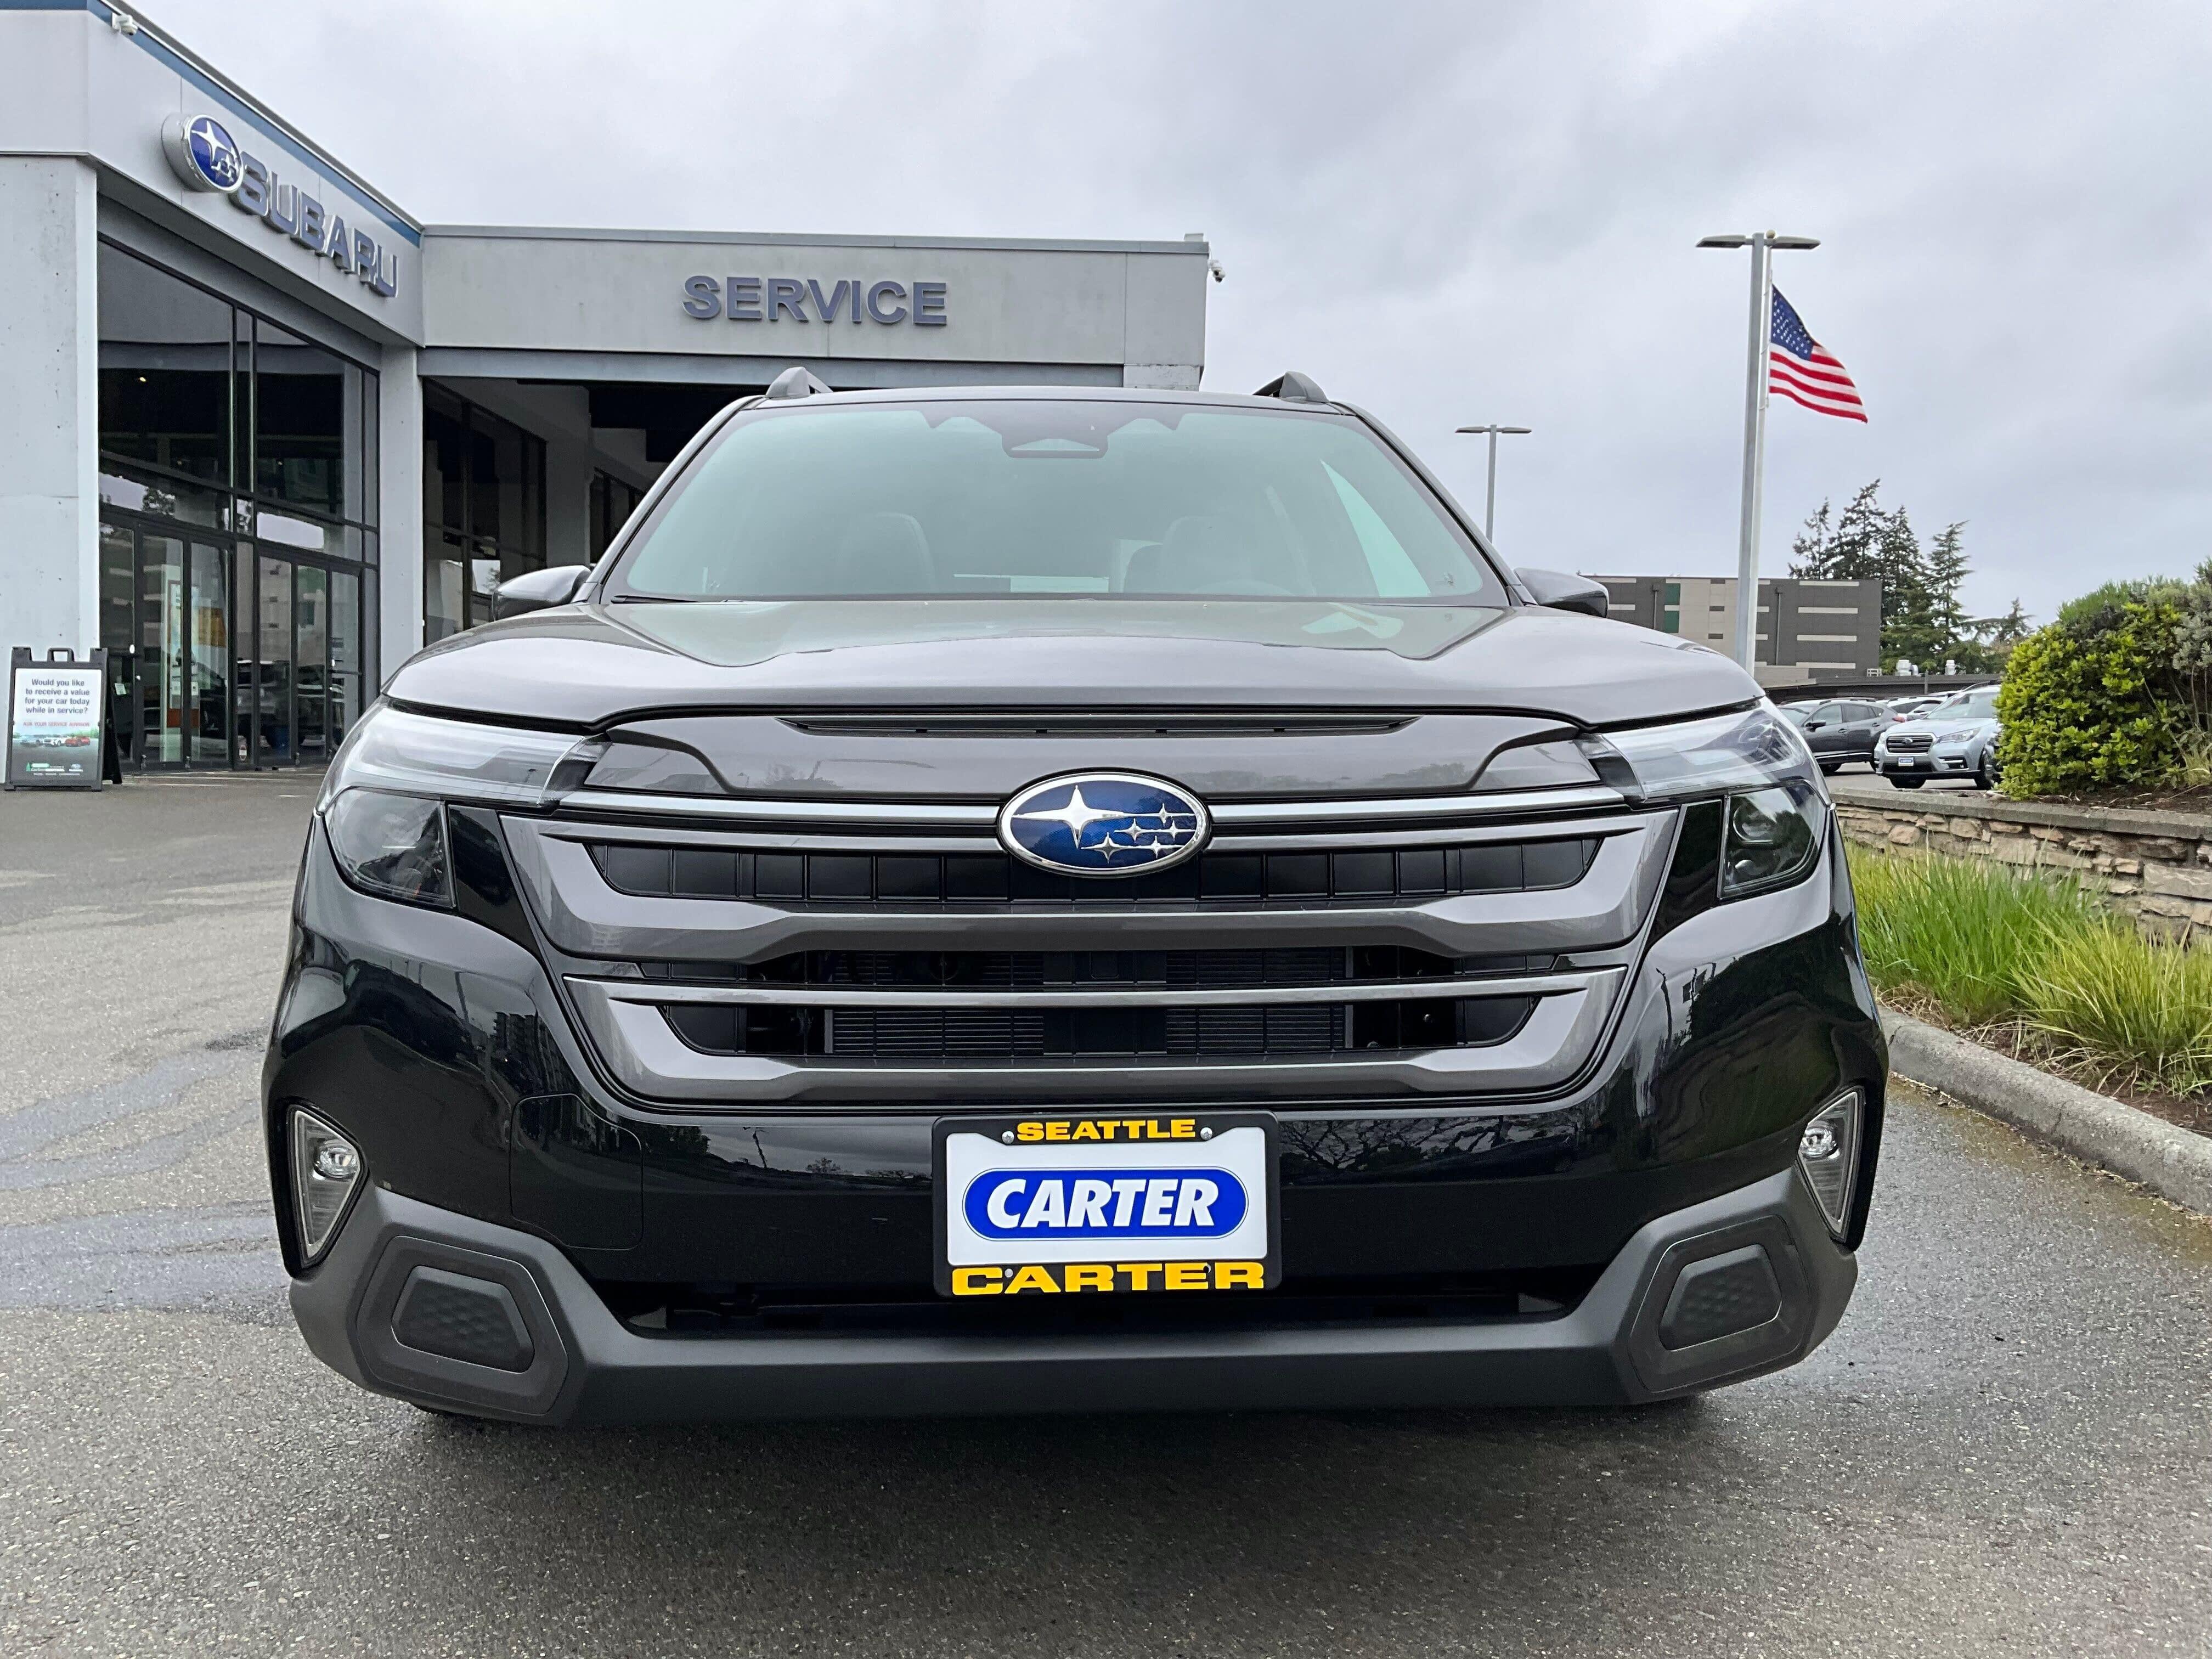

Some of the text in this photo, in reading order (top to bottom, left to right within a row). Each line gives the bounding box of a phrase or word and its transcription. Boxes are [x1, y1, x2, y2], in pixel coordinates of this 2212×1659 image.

[230, 151, 398, 297] SUBARU
[682, 275, 947, 326] SERVICE
[1016, 1119, 1196, 1141] SEATTLE
[986, 1178, 1219, 1229] CARTER
[952, 1262, 1265, 1296] CARTER
